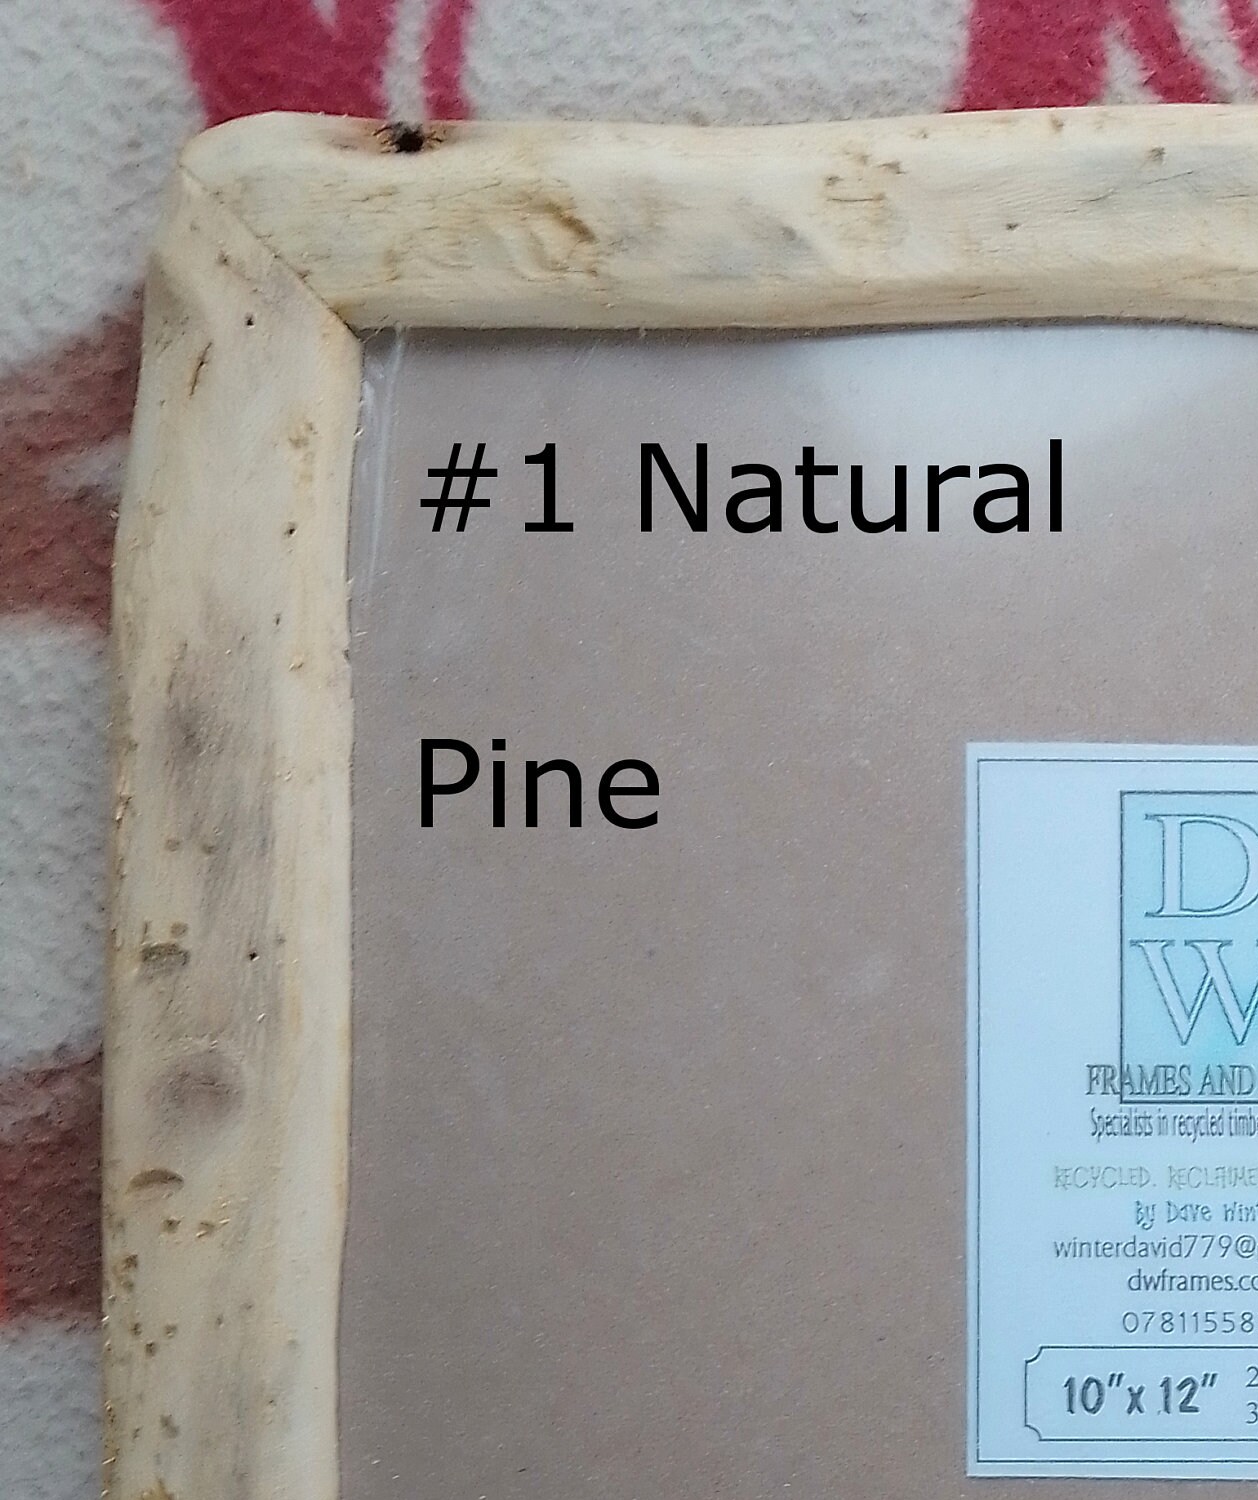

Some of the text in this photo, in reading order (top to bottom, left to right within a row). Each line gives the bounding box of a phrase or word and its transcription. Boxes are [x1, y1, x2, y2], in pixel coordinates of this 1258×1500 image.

[1085, 1064, 1192, 1097] FRAMES
[1200, 1064, 1256, 1096] AND
[1090, 1108, 1153, 1142] Specialists
[1158, 1111, 1168, 1136] in
[1171, 1110, 1223, 1141] recycled
[1135, 1201, 1155, 1229] By
[1166, 1202, 1212, 1223] Dave
